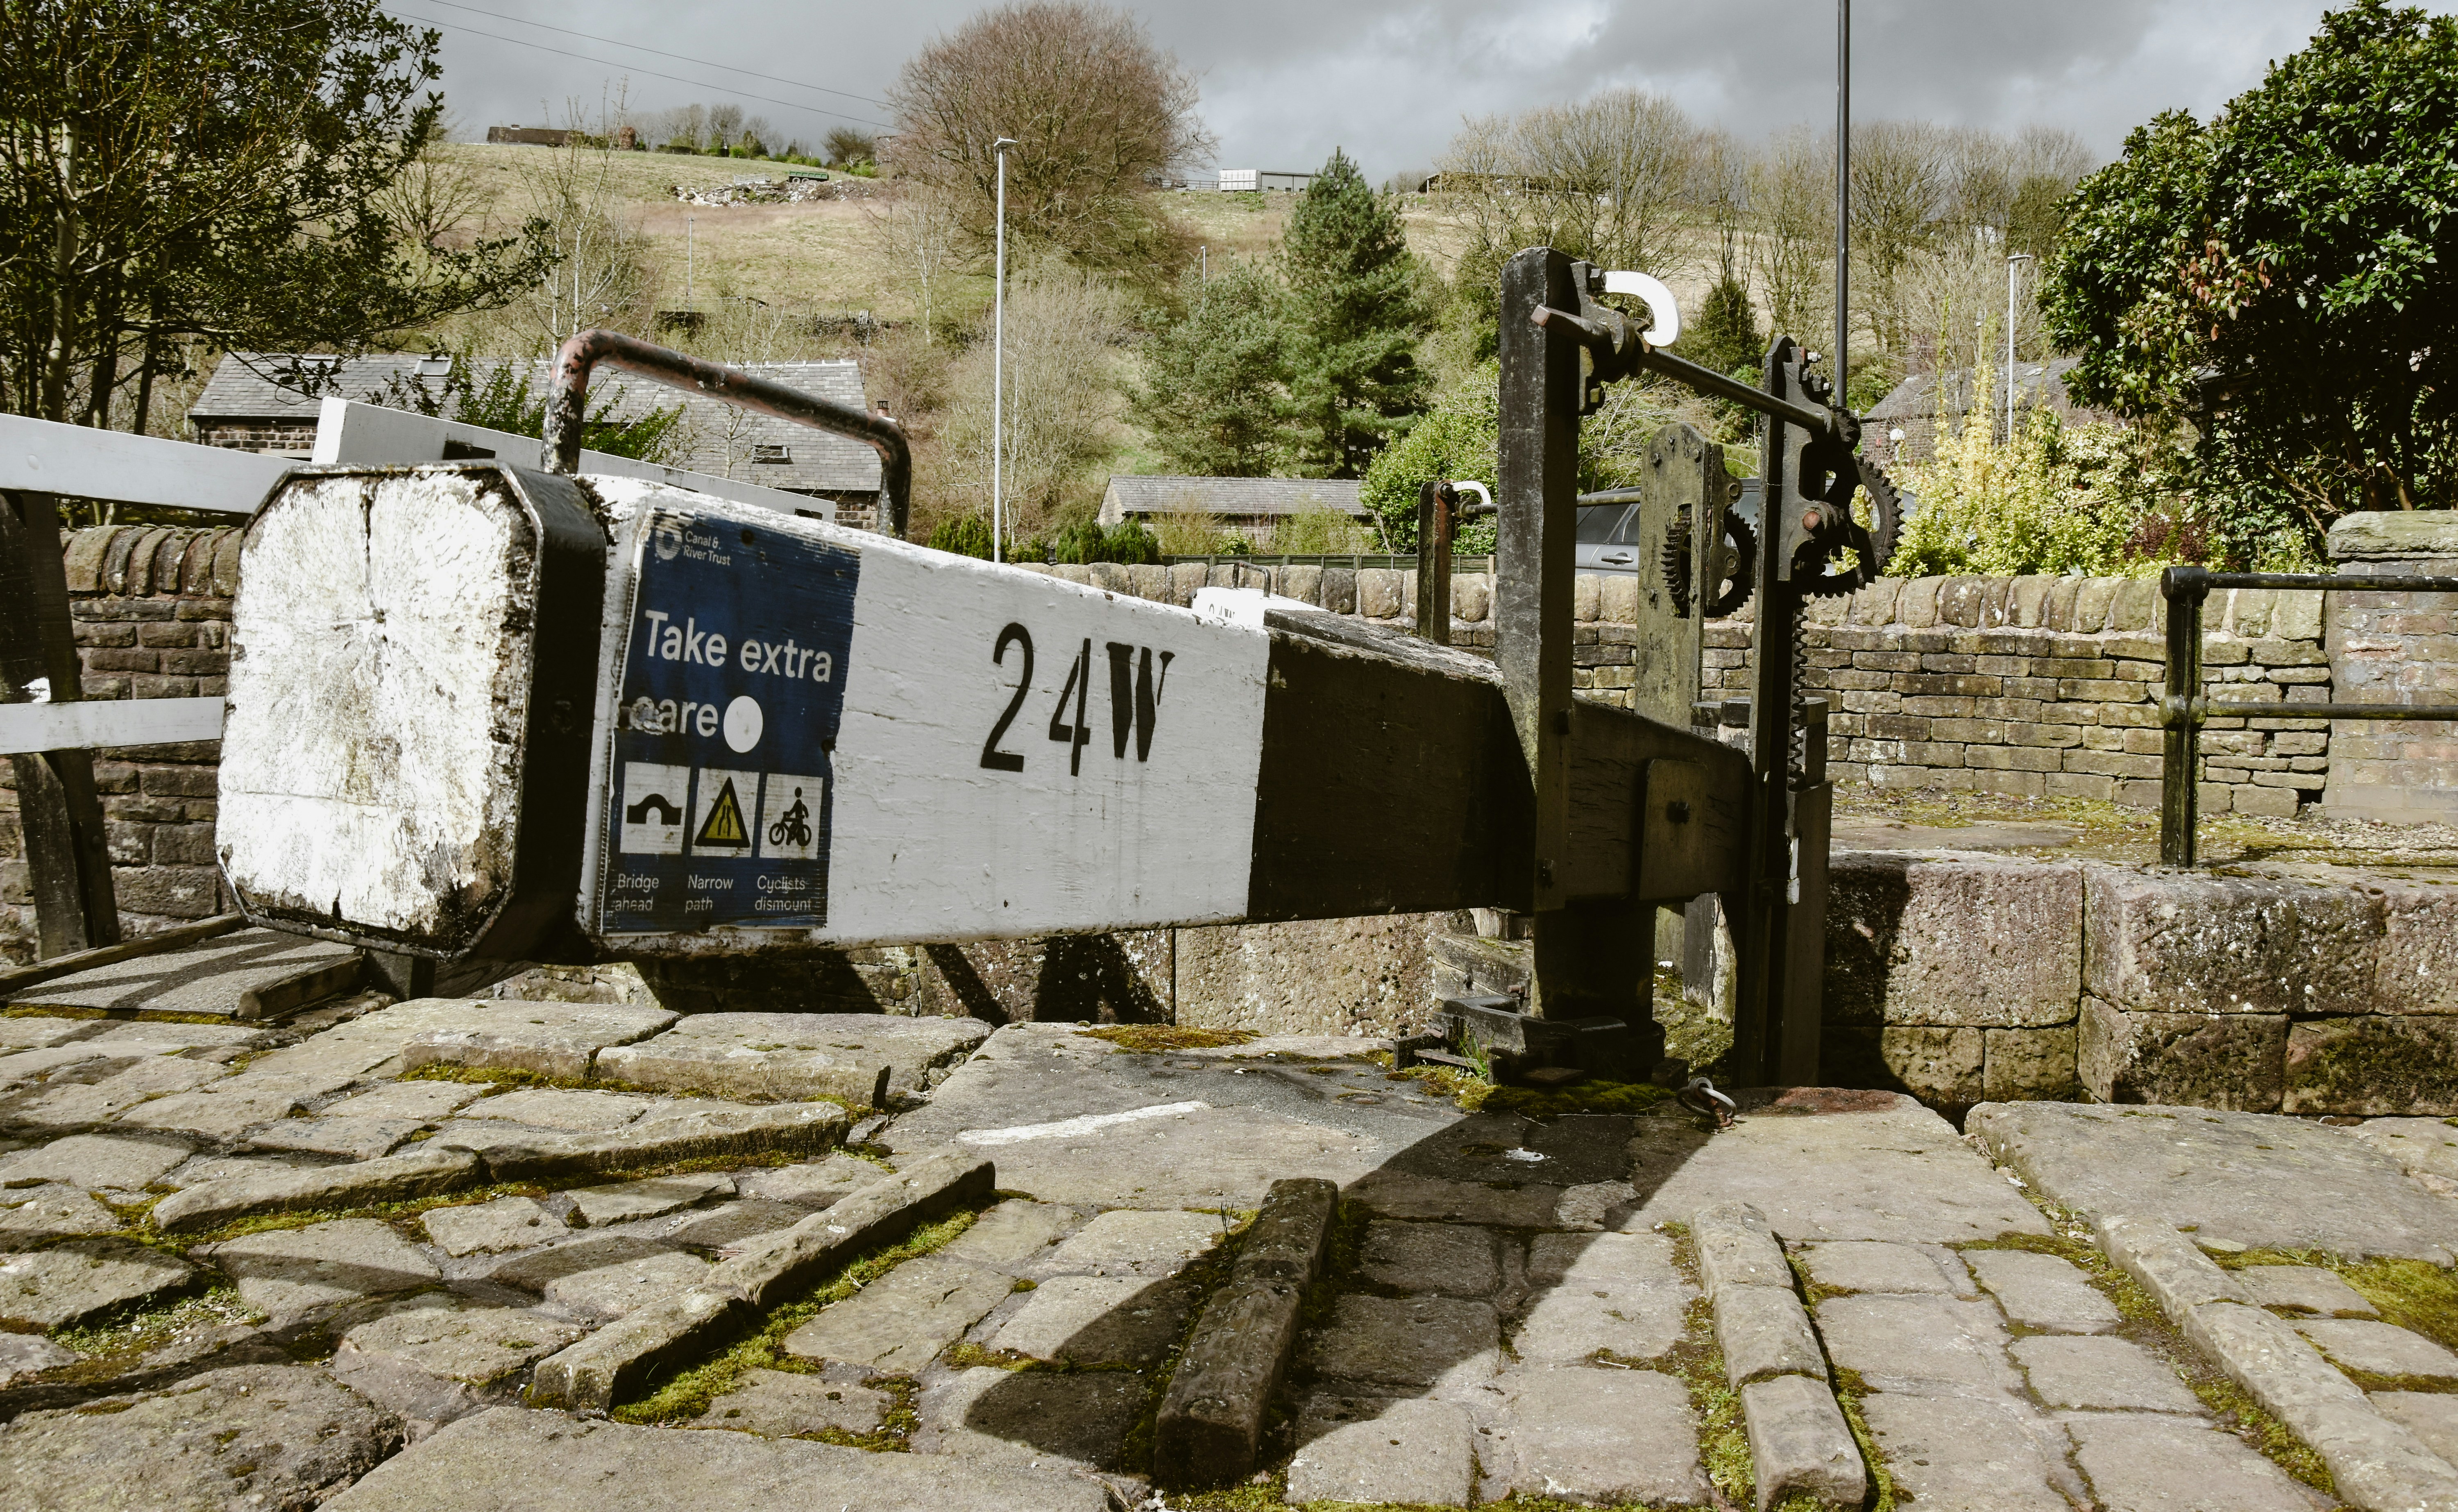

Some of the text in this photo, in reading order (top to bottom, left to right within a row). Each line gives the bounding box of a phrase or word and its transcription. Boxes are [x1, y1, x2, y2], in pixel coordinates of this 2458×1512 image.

[685, 531, 719, 548] Canal &
[683, 545, 731, 566] River Trust
[645, 609, 832, 682] Take extra
[980, 622, 1175, 776] 24W
[629, 696, 718, 737] care
[618, 874, 659, 893] Bridge
[688, 874, 734, 890] Narrow
[757, 875, 806, 894] Cyclists
[614, 896, 653, 911] ahead
[685, 896, 713, 914] path
[755, 896, 812, 912] dismount
